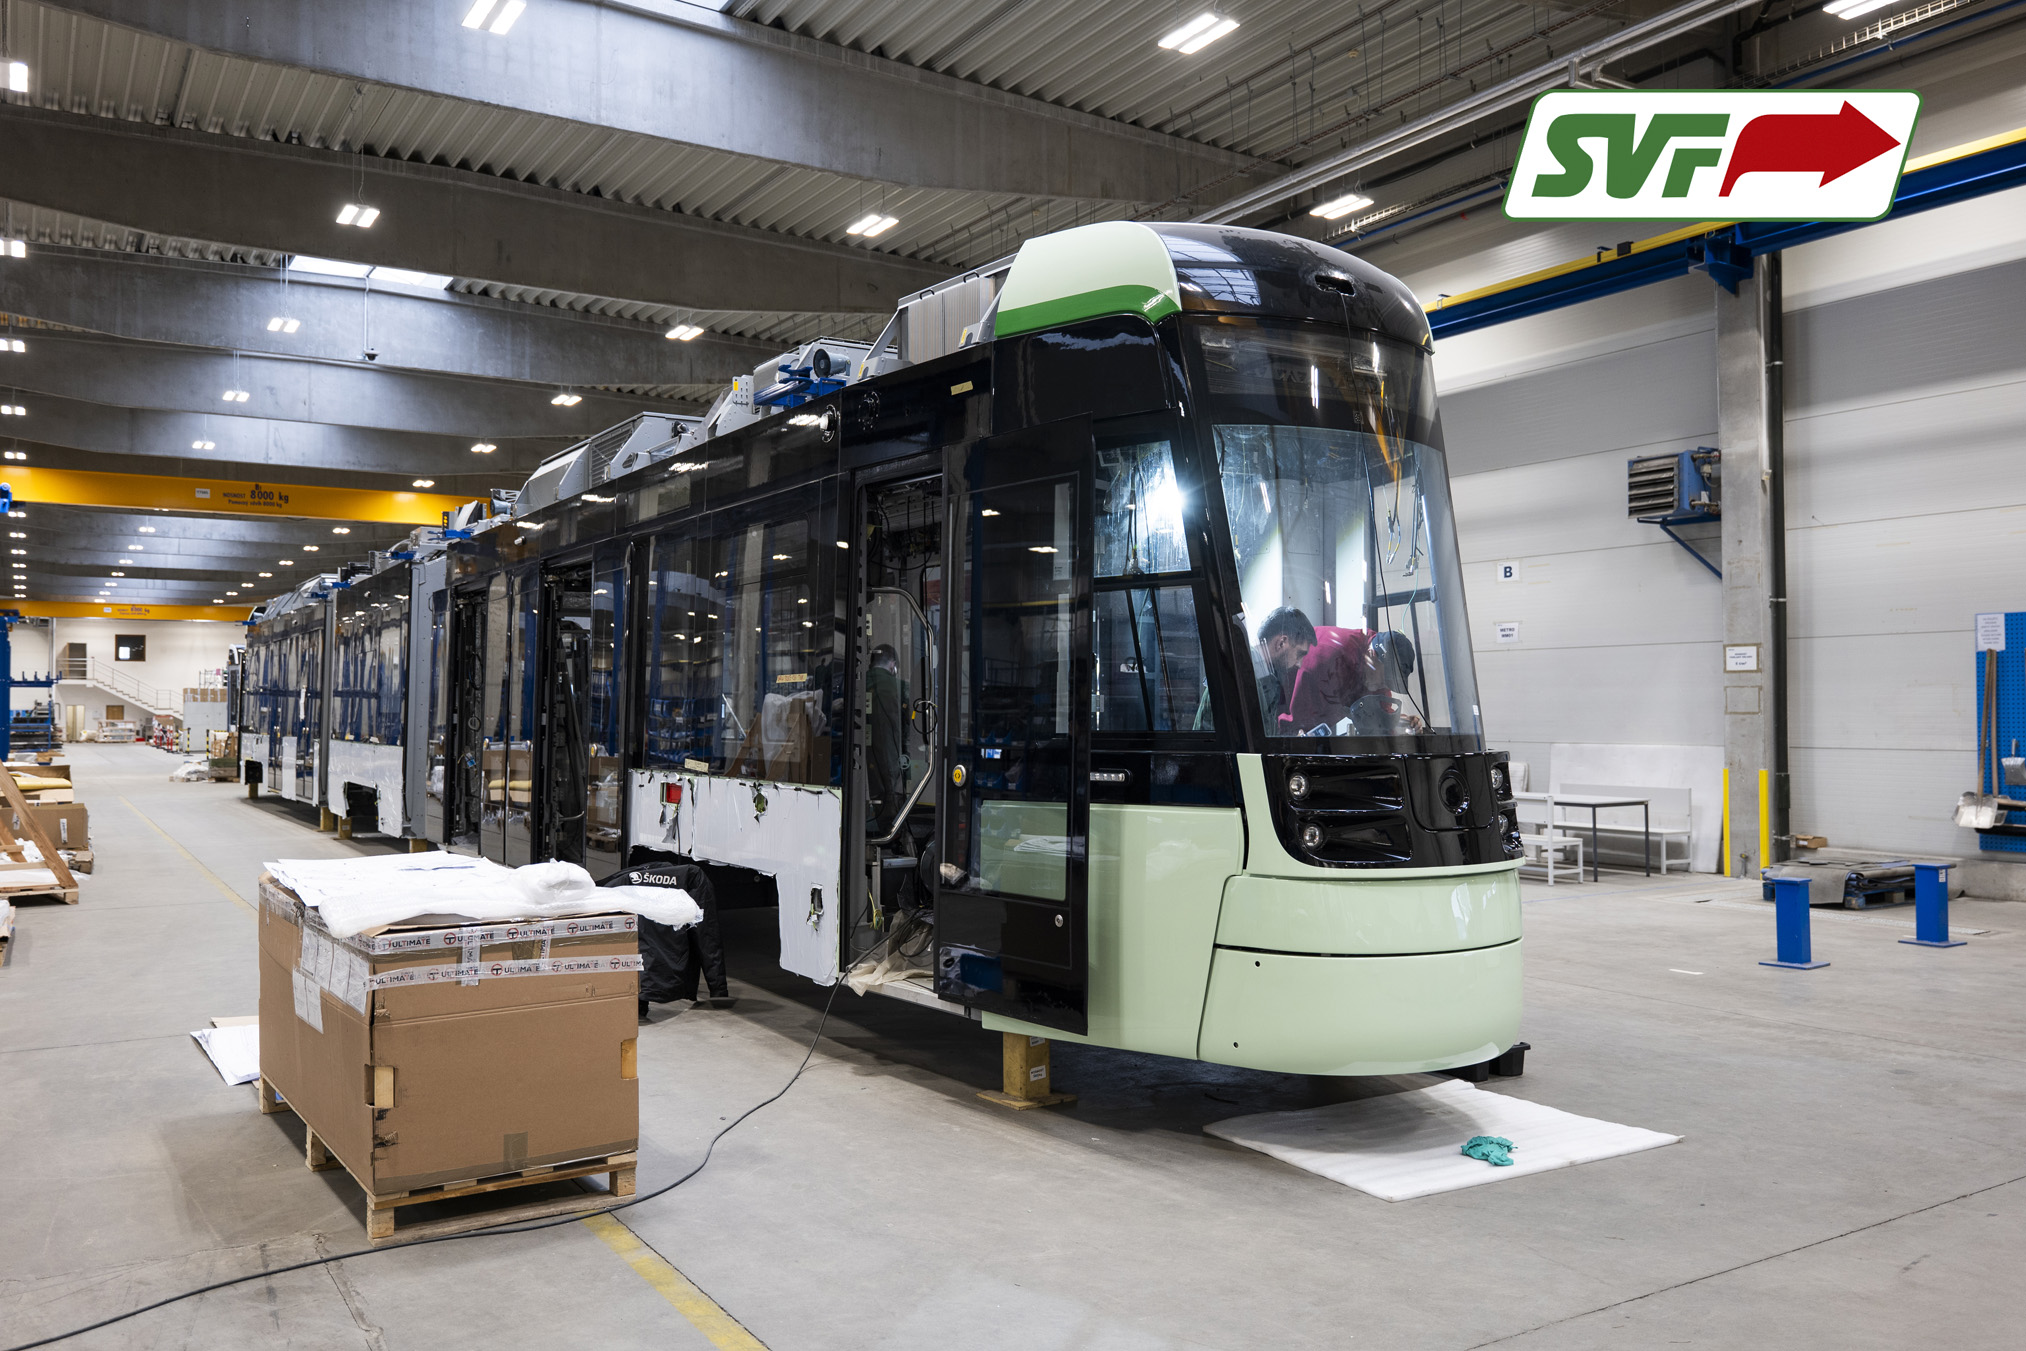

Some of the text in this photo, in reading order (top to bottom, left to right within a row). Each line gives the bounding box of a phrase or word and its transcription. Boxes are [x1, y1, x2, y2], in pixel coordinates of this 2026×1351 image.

[250, 490, 274, 500] 8000
[279, 492, 289, 503] kg
[1504, 566, 1513, 578] B
[643, 872, 677, 885] ŠKODA
[392, 938, 431, 948] ULTIMATE
[520, 928, 555, 937] ULTIMATE
[580, 923, 613, 932] ULTIMATE
[375, 974, 414, 985] ULTIMATE
[441, 969, 479, 978] ULTIMATE
[564, 961, 598, 970] ULTIMATE
